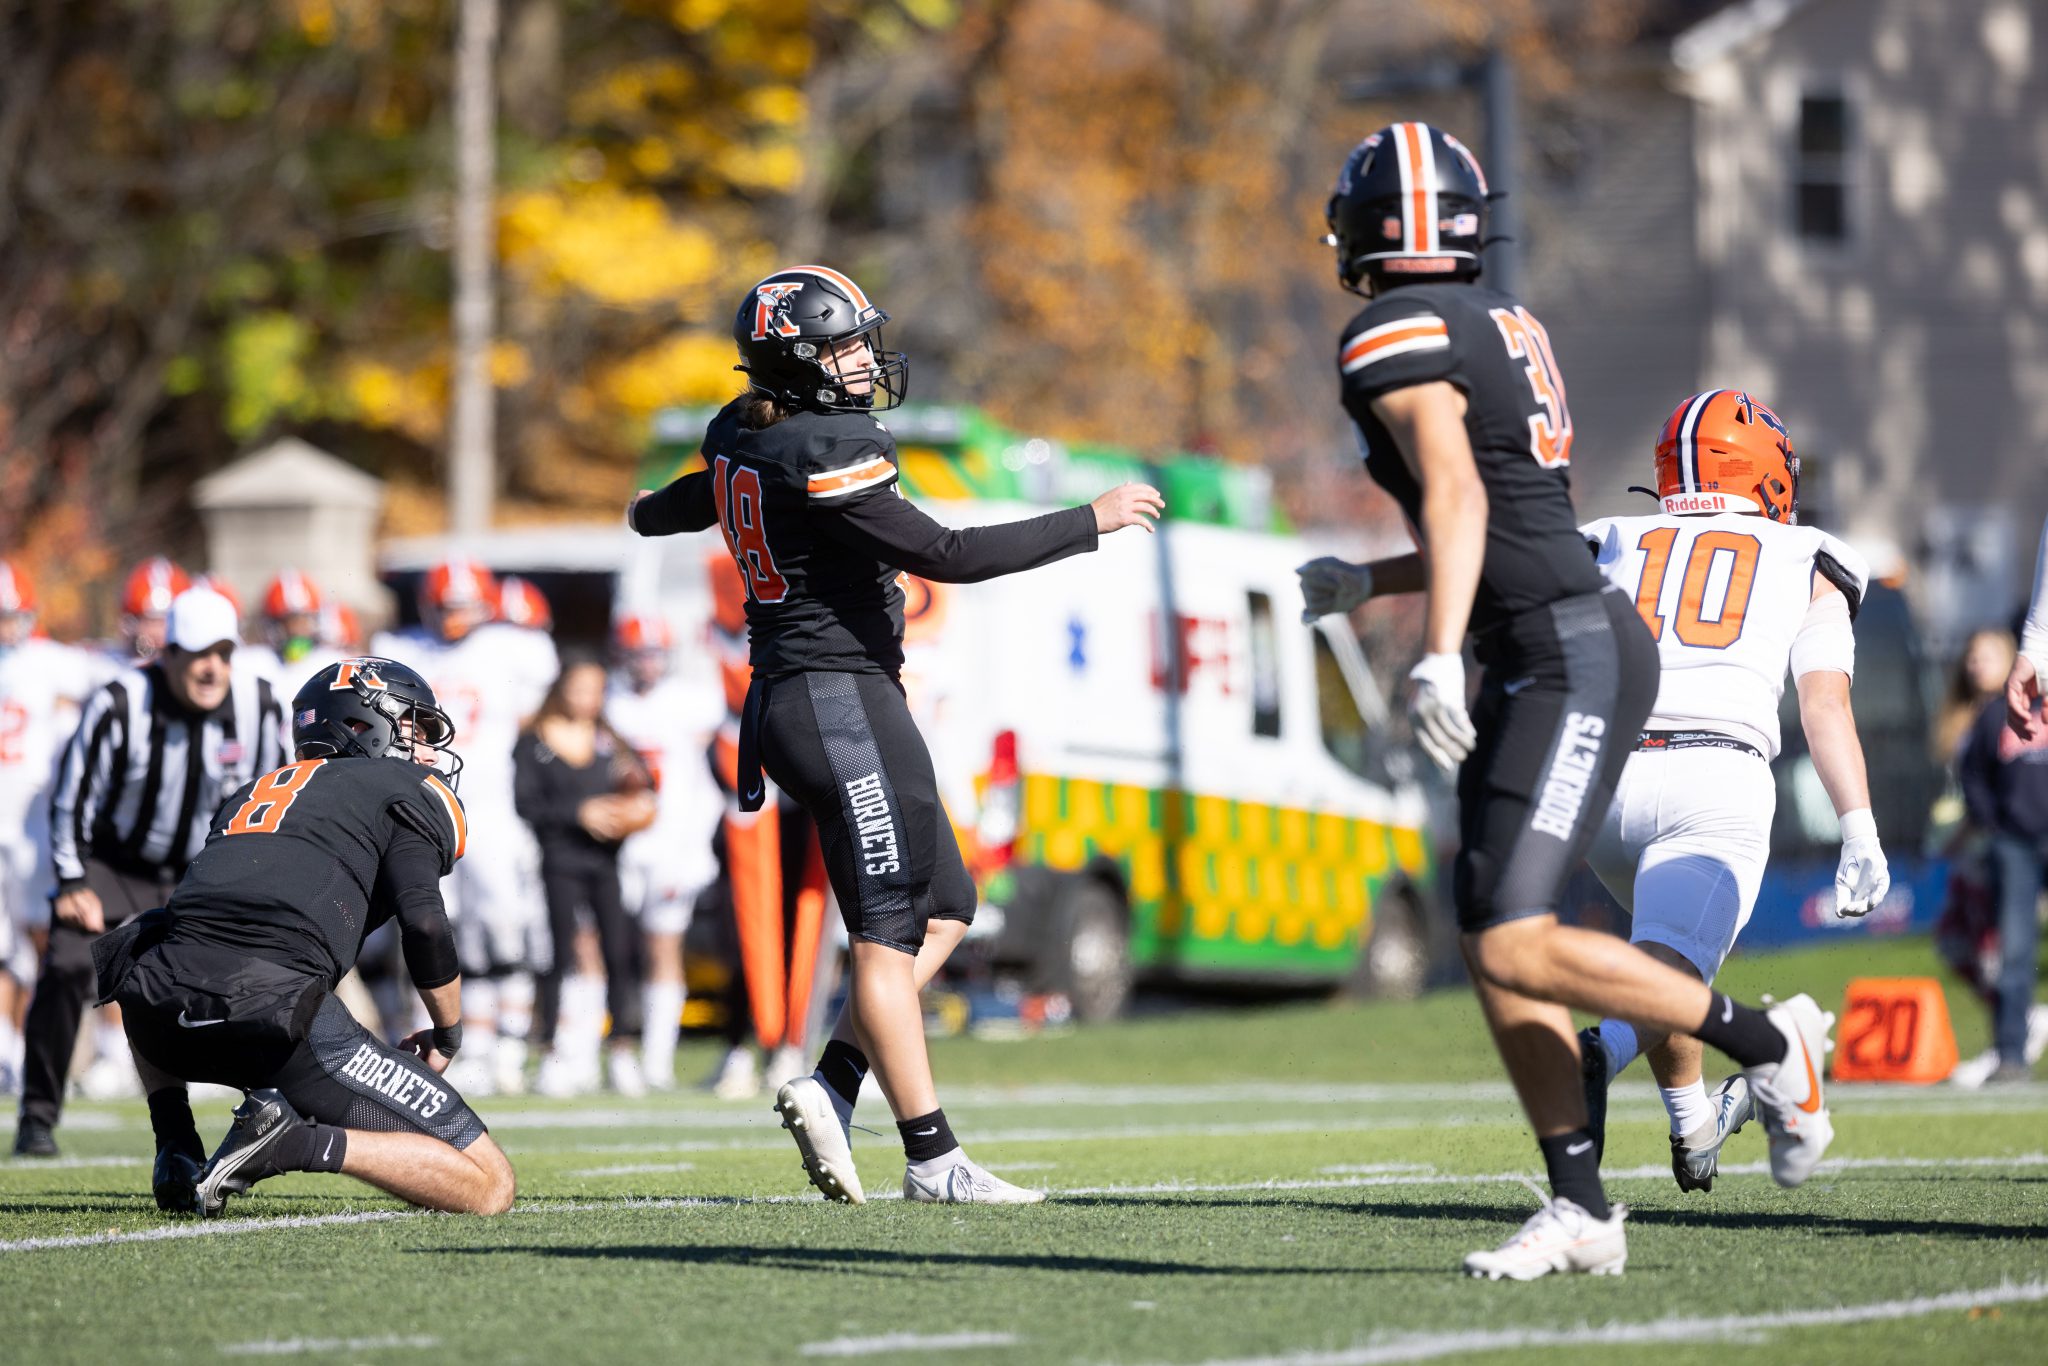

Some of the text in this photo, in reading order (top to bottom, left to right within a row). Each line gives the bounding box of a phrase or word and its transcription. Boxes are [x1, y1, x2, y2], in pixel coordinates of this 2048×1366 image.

[1665, 495, 1726, 513] Riddell
[1634, 526, 1763, 650] 10
[222, 758, 328, 836] 8
[1530, 711, 1606, 842] HORNETS
[845, 771, 900, 876] HORNETS
[1847, 997, 1918, 1068] 20
[341, 1043, 448, 1118] HORNETS
